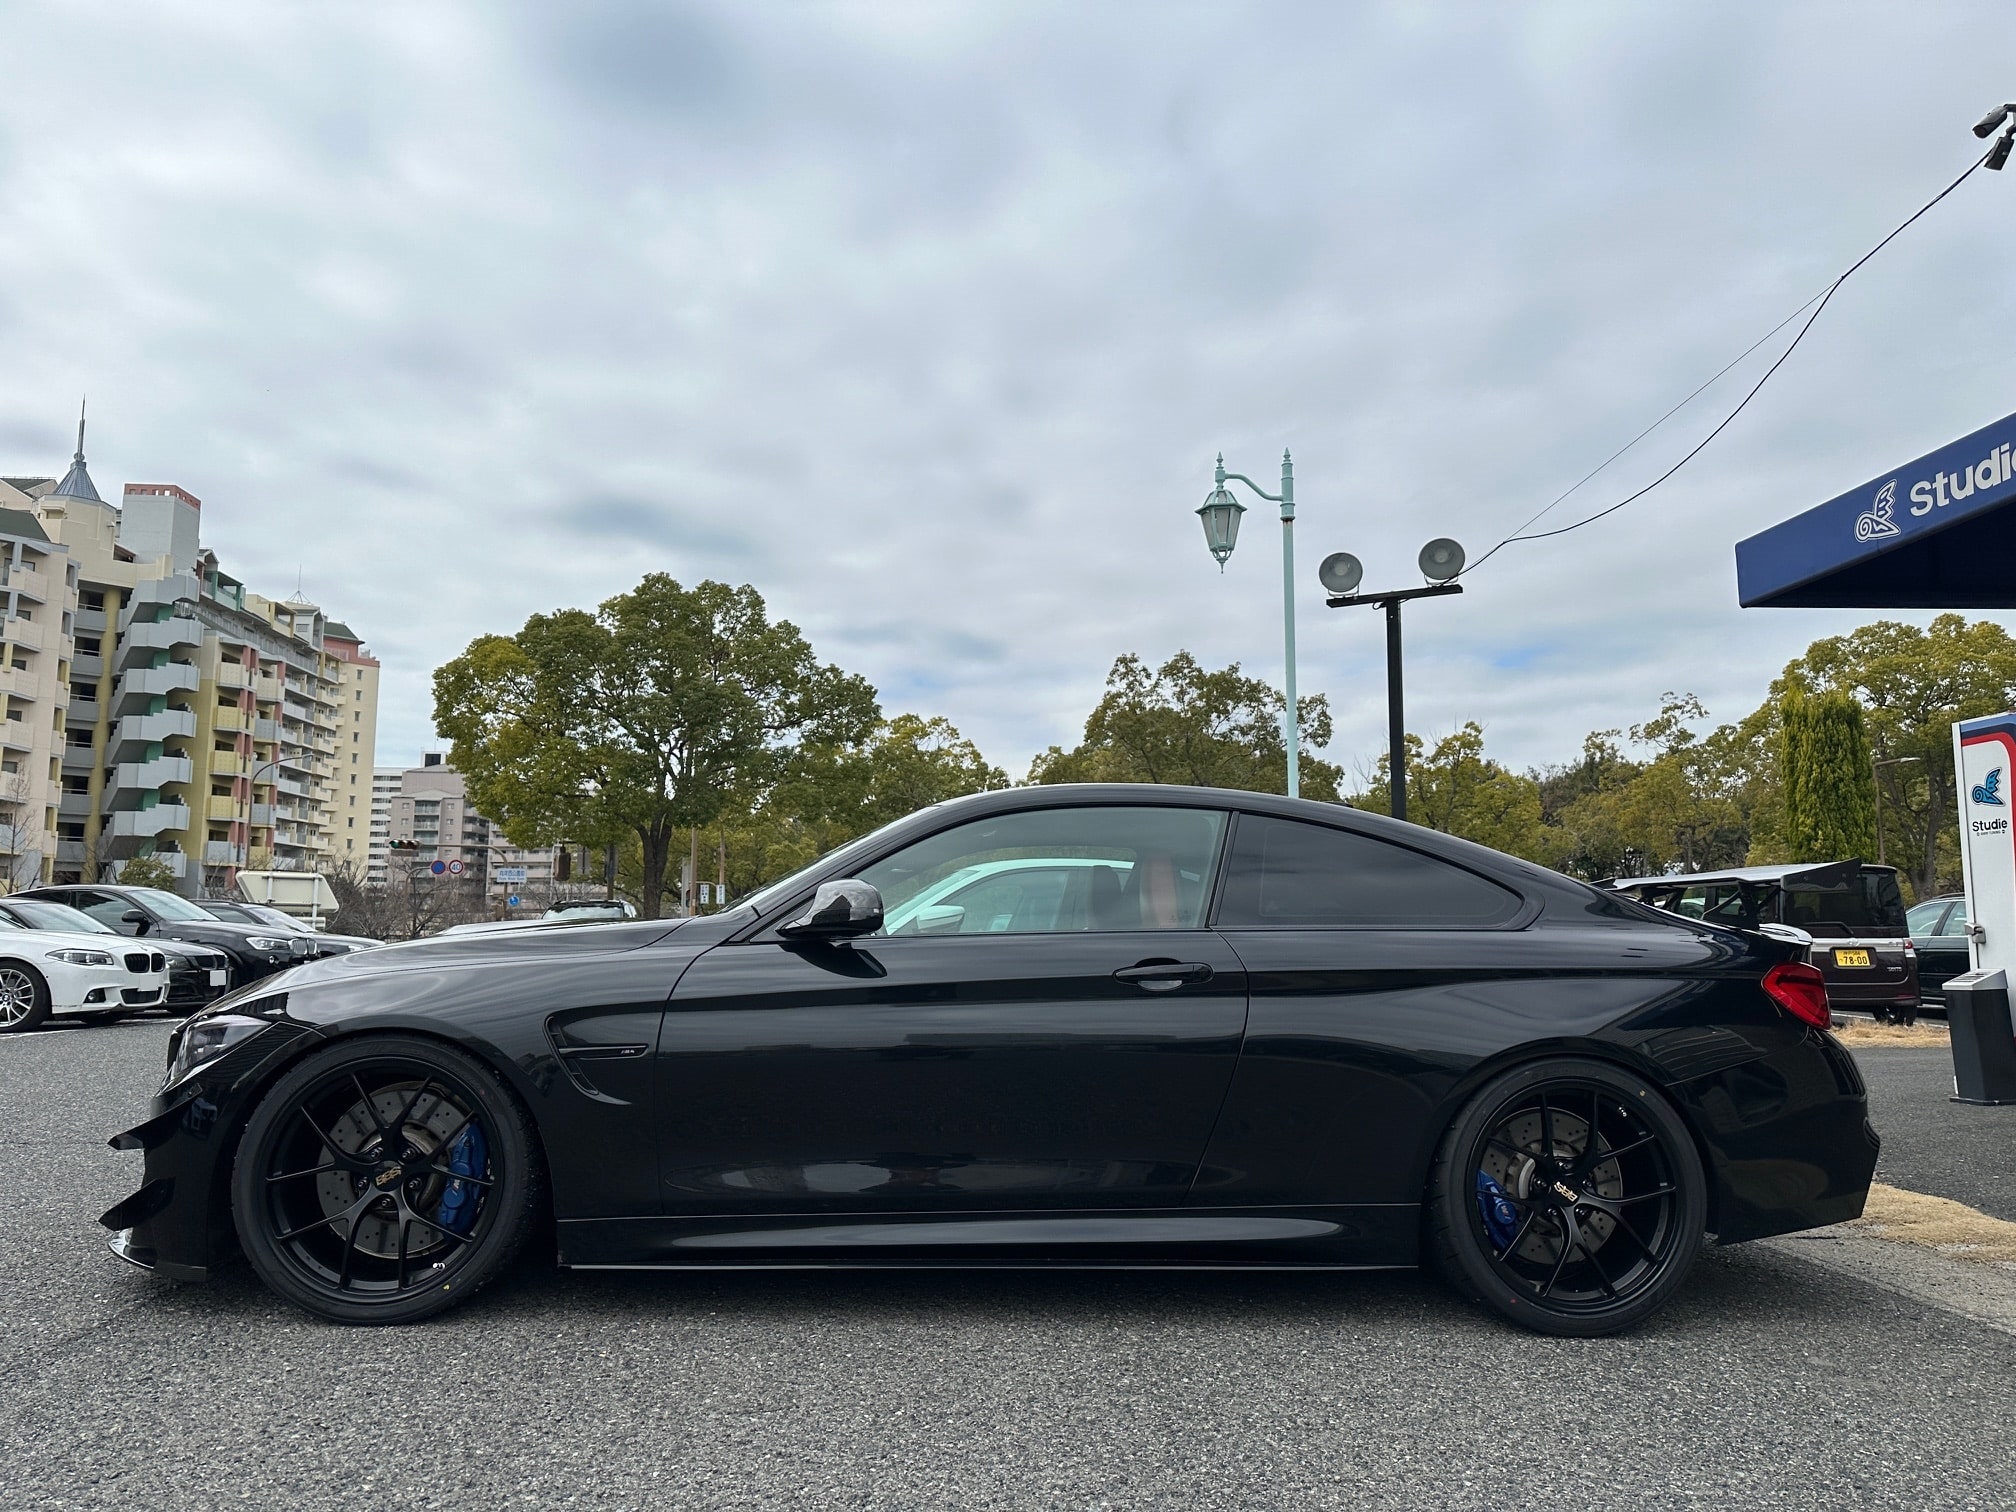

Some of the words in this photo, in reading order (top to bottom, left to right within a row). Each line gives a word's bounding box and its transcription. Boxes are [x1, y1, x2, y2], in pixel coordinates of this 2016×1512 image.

[1910, 443, 2016, 516] Studi
[1972, 818, 2007, 832] Studie
[1843, 956, 1868, 964] 78-00
[375, 1166, 401, 1186] BBS
[1553, 1181, 1578, 1202] BBS
